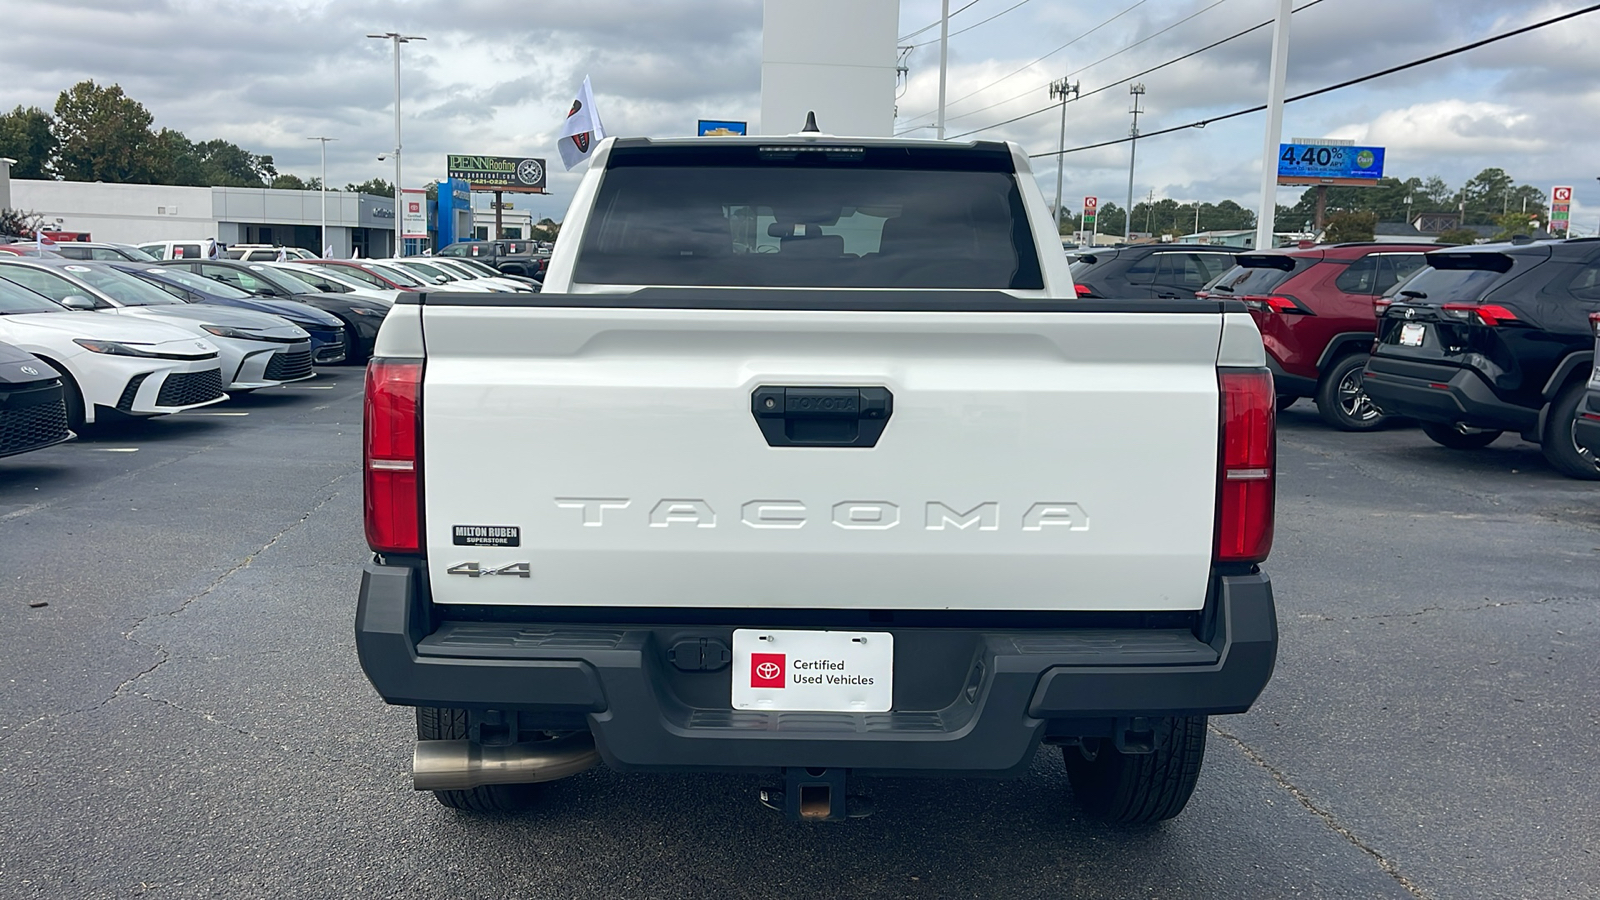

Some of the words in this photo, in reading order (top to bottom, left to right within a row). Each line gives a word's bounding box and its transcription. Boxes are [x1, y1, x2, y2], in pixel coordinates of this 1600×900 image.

[1281, 146, 1343, 166] 4.40%
[449, 156, 491, 169] PENN
[490, 160, 516, 172] Roofing
[788, 396, 856, 410] TOYOTA
[554, 496, 1090, 531] TACOMA
[455, 526, 487, 537] MILTON
[488, 527, 517, 538] RUBEN
[447, 562, 530, 578] 4x4
[793, 660, 844, 670] Certified
[793, 674, 823, 684] Used
[826, 675, 874, 685] Vehicles
